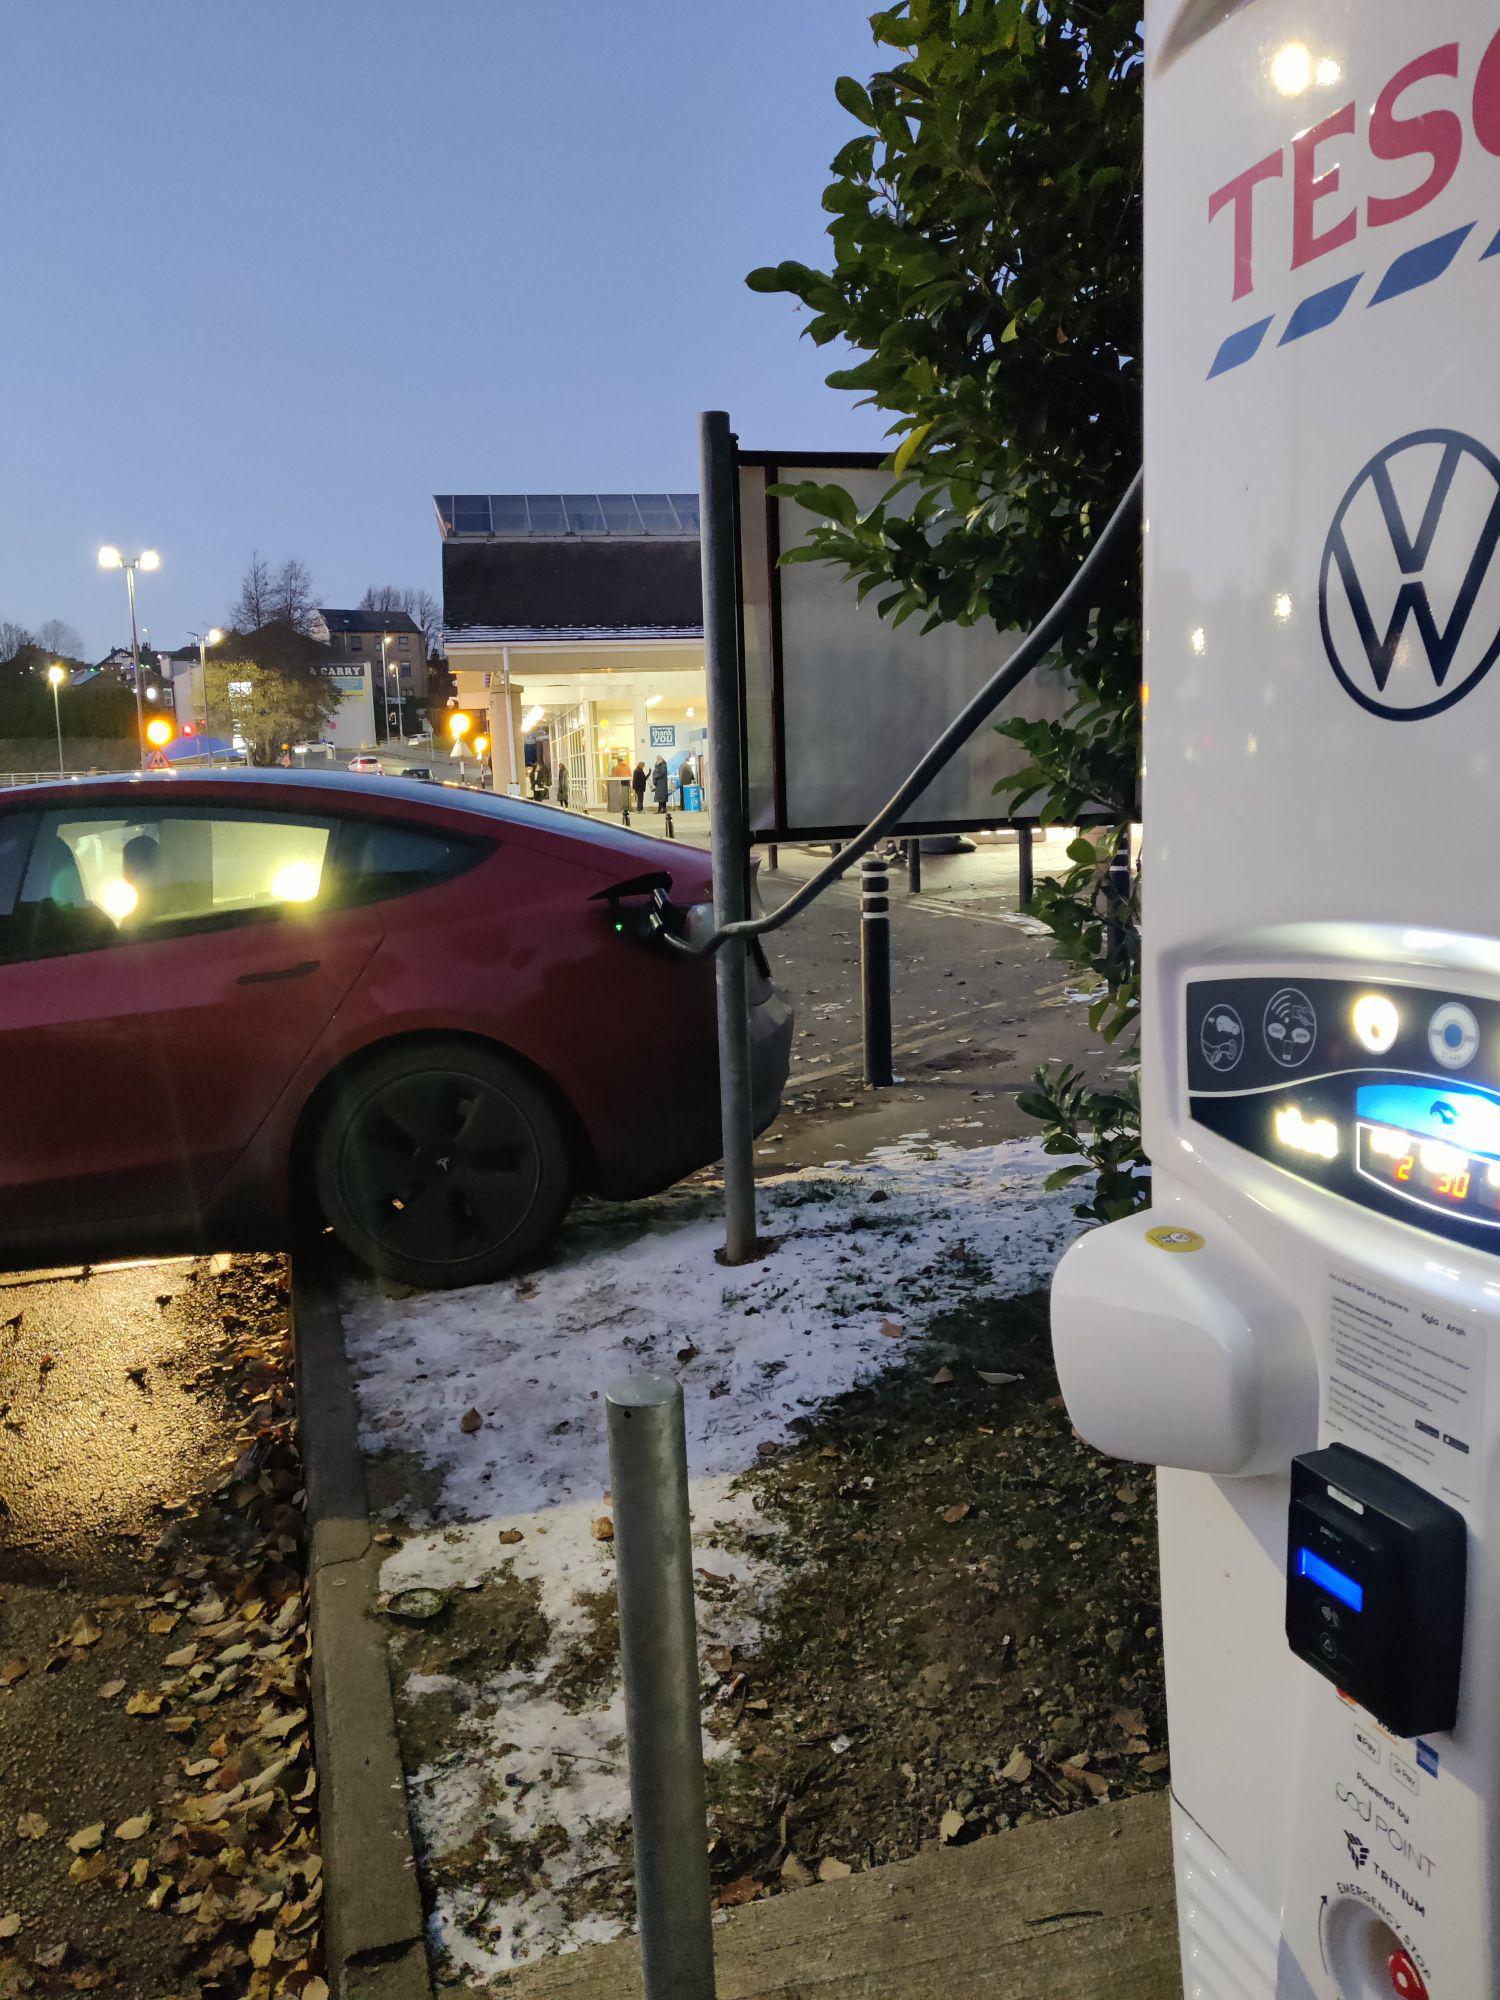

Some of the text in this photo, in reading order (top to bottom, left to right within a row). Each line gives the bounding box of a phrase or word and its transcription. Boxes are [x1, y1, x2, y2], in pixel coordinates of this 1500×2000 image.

[320, 667, 361, 676] CARRY
[652, 729, 673, 737] thank
[652, 735, 673, 745] you
[1375, 1814, 1436, 1877] POINT
[1373, 1861, 1425, 1917] TRITIUM
[1336, 1881, 1431, 1979] EMERGENCY STOP
